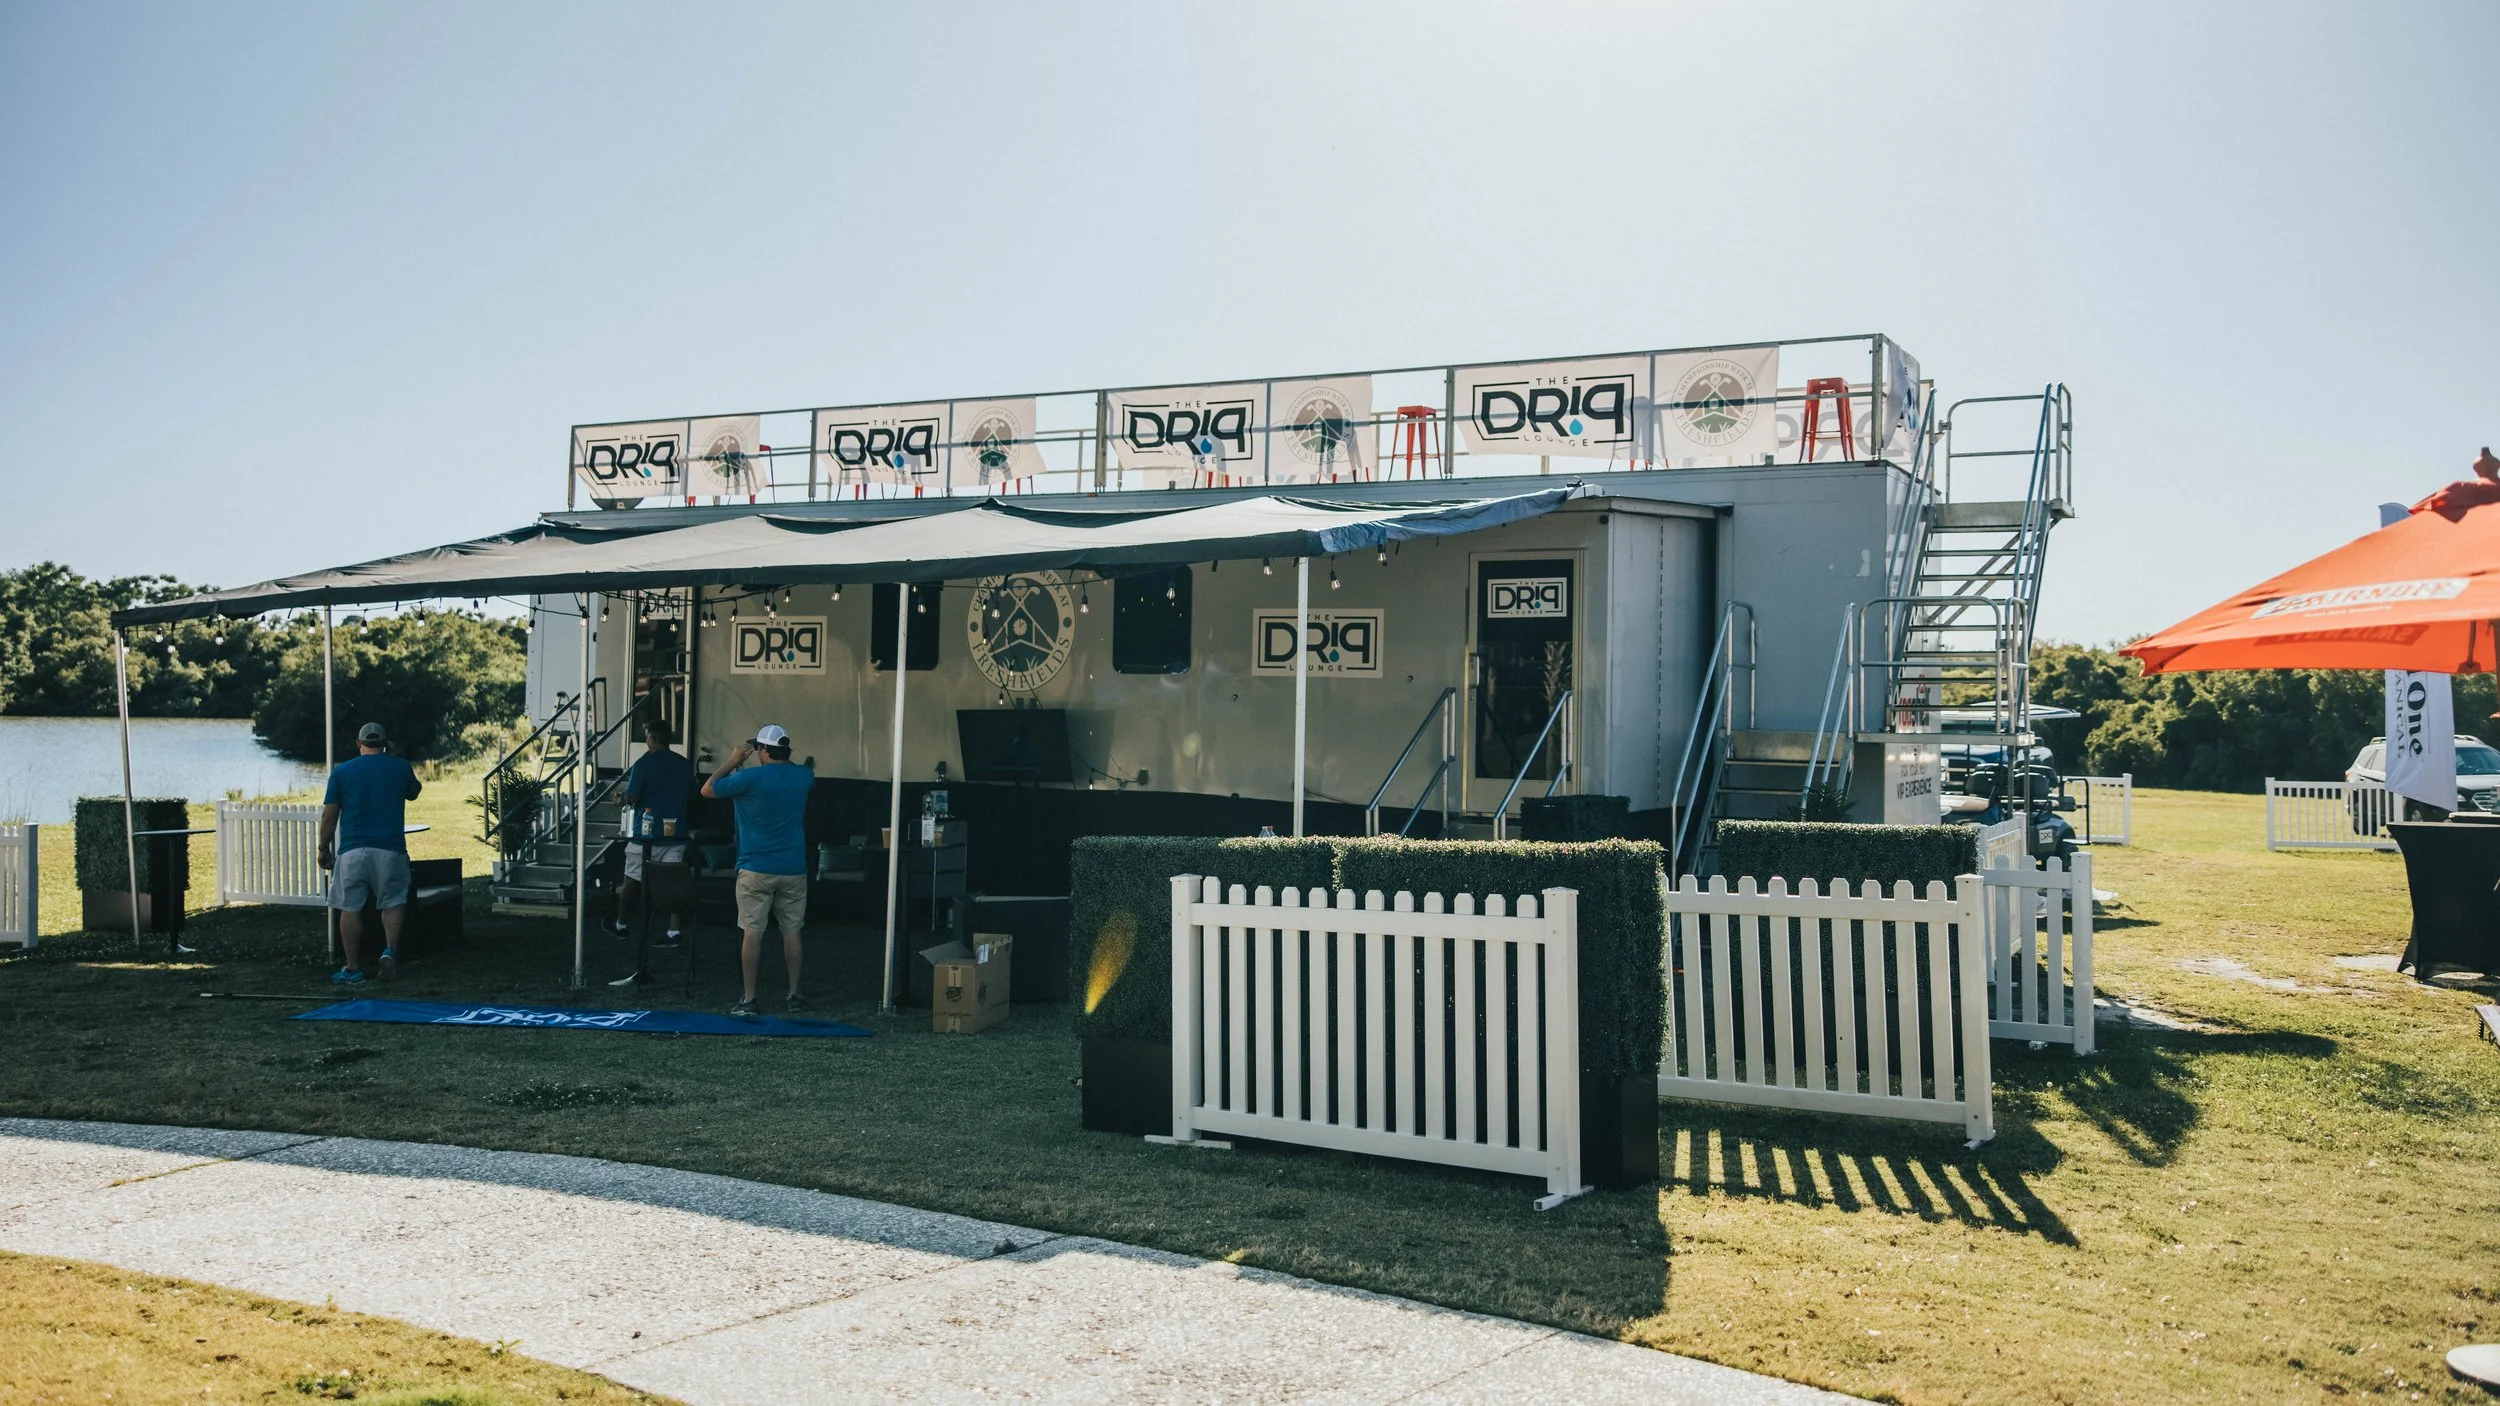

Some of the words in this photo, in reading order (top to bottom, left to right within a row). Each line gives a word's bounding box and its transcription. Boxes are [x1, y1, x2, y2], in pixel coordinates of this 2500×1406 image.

[1535, 376, 1568, 386] THE
[1175, 400, 1202, 409] THE
[873, 418, 896, 426] THE
[1676, 410, 1754, 445] FRESHFIELDS
[1523, 434, 1588, 447] LOUGE
[973, 637, 1070, 689] FRESHFIELDS
[1289, 664, 1343, 672] LUNGE
[2395, 671, 2405, 758] ANICAL
[2407, 681, 2426, 758] One
